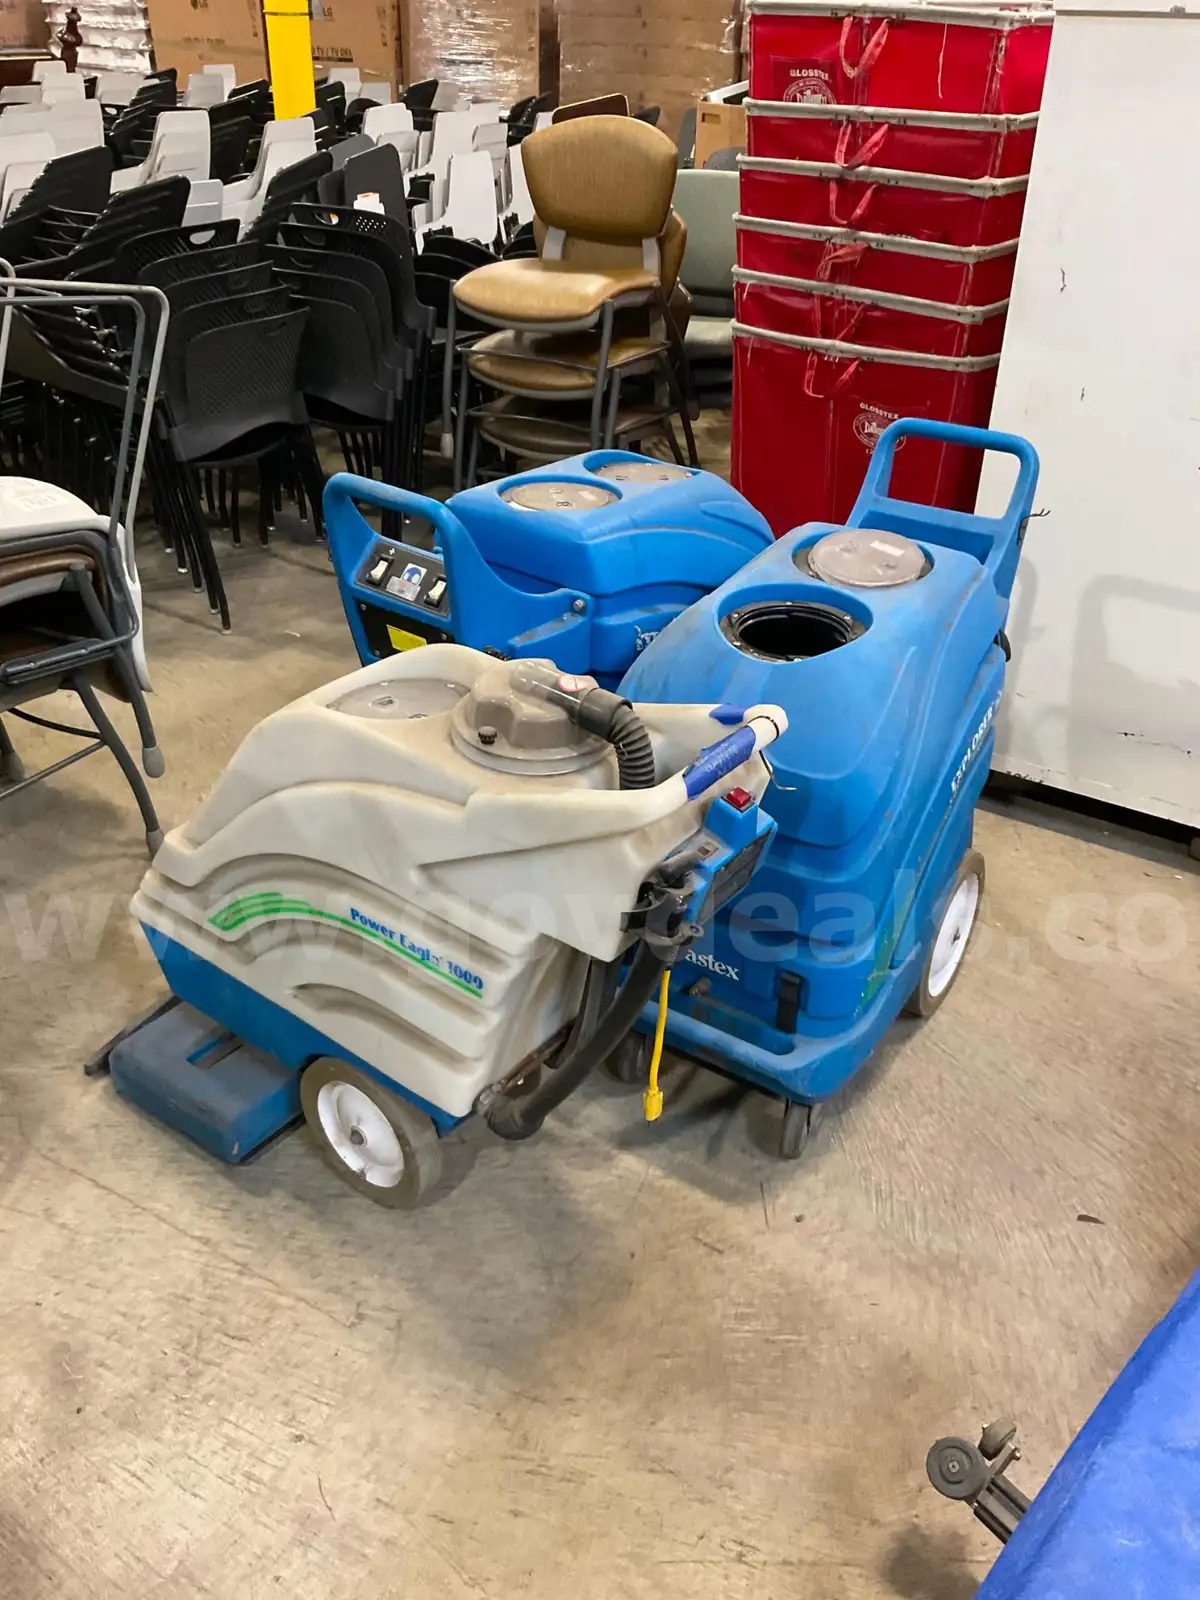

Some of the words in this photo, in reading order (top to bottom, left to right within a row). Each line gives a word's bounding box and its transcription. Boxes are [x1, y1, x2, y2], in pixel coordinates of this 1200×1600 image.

[860, 403, 898, 419] GLOSSTEX
[350, 907, 396, 940] Power
[684, 949, 740, 981] astex
